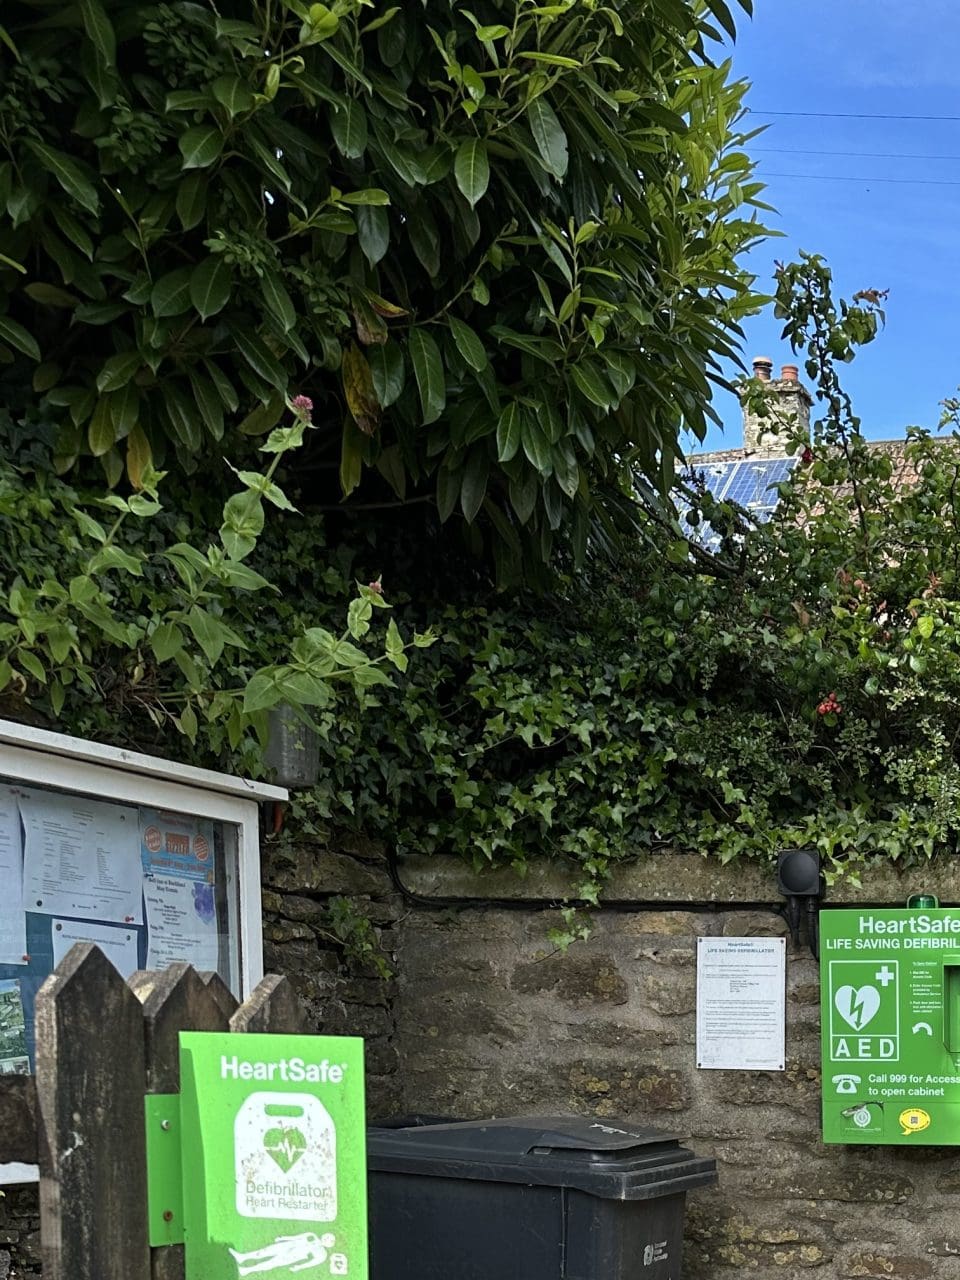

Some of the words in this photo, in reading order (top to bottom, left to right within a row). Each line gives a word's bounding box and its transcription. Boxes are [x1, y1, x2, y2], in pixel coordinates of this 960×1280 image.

[827, 938, 851, 950] LIFE
[855, 938, 899, 949] SAVING
[868, 1074, 887, 1083] Call
[889, 1074, 907, 1083] 999
[909, 1074, 923, 1083] for
[925, 1074, 960, 1083] Access
[868, 1087, 878, 1096] to
[881, 1088, 905, 1097] open
[908, 1087, 944, 1096] cabinet
[246, 1181, 329, 1198] Defibrillator
[246, 1196, 275, 1209] Heart
[278, 1197, 328, 1211] Restarter
